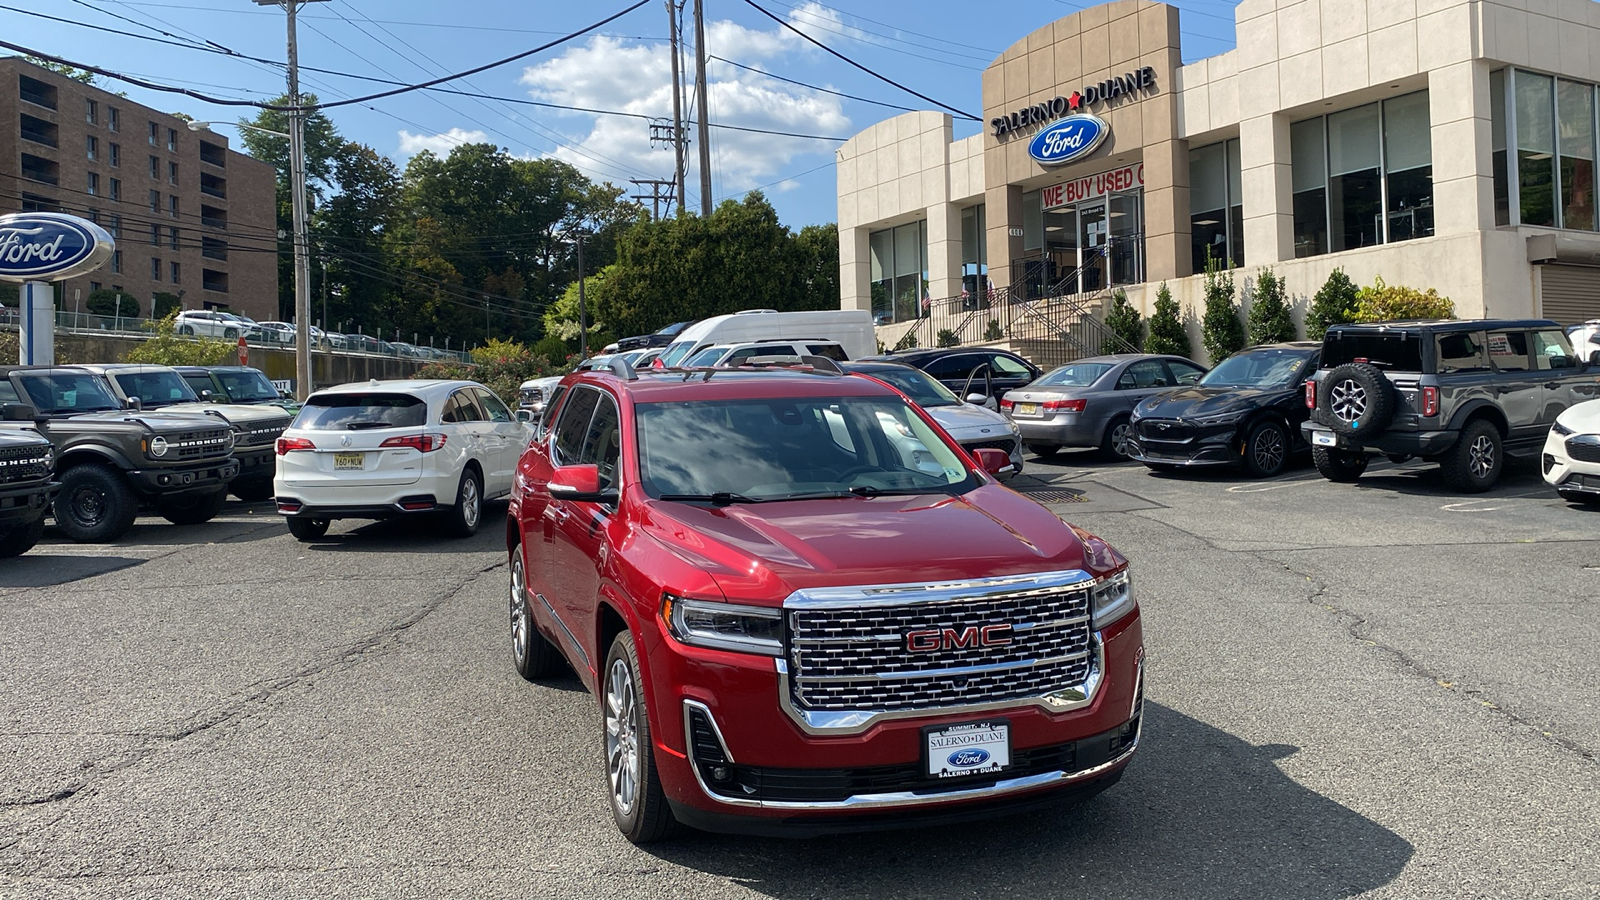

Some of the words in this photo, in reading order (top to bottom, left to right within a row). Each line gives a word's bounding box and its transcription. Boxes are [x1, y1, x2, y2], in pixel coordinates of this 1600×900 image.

[991, 96, 1067, 136] SALERNO
[1084, 66, 1154, 106] DUANE
[1042, 126, 1084, 157] Ford
[1043, 185, 1063, 207] WE
[1067, 178, 1092, 202] BUY
[1097, 168, 1133, 194] USED
[0, 227, 65, 263] Ford
[273, 381, 288, 390] XIT
[251, 427, 287, 435] BRONCO
[181, 438, 224, 447] BRONCO
[906, 623, 1013, 652] GMC
[931, 735, 971, 748] SALERNO
[975, 731, 1005, 743] DUANE
[956, 751, 982, 765] Ford
[938, 769, 971, 779] SALERNO
[980, 765, 1003, 774] DUANE
